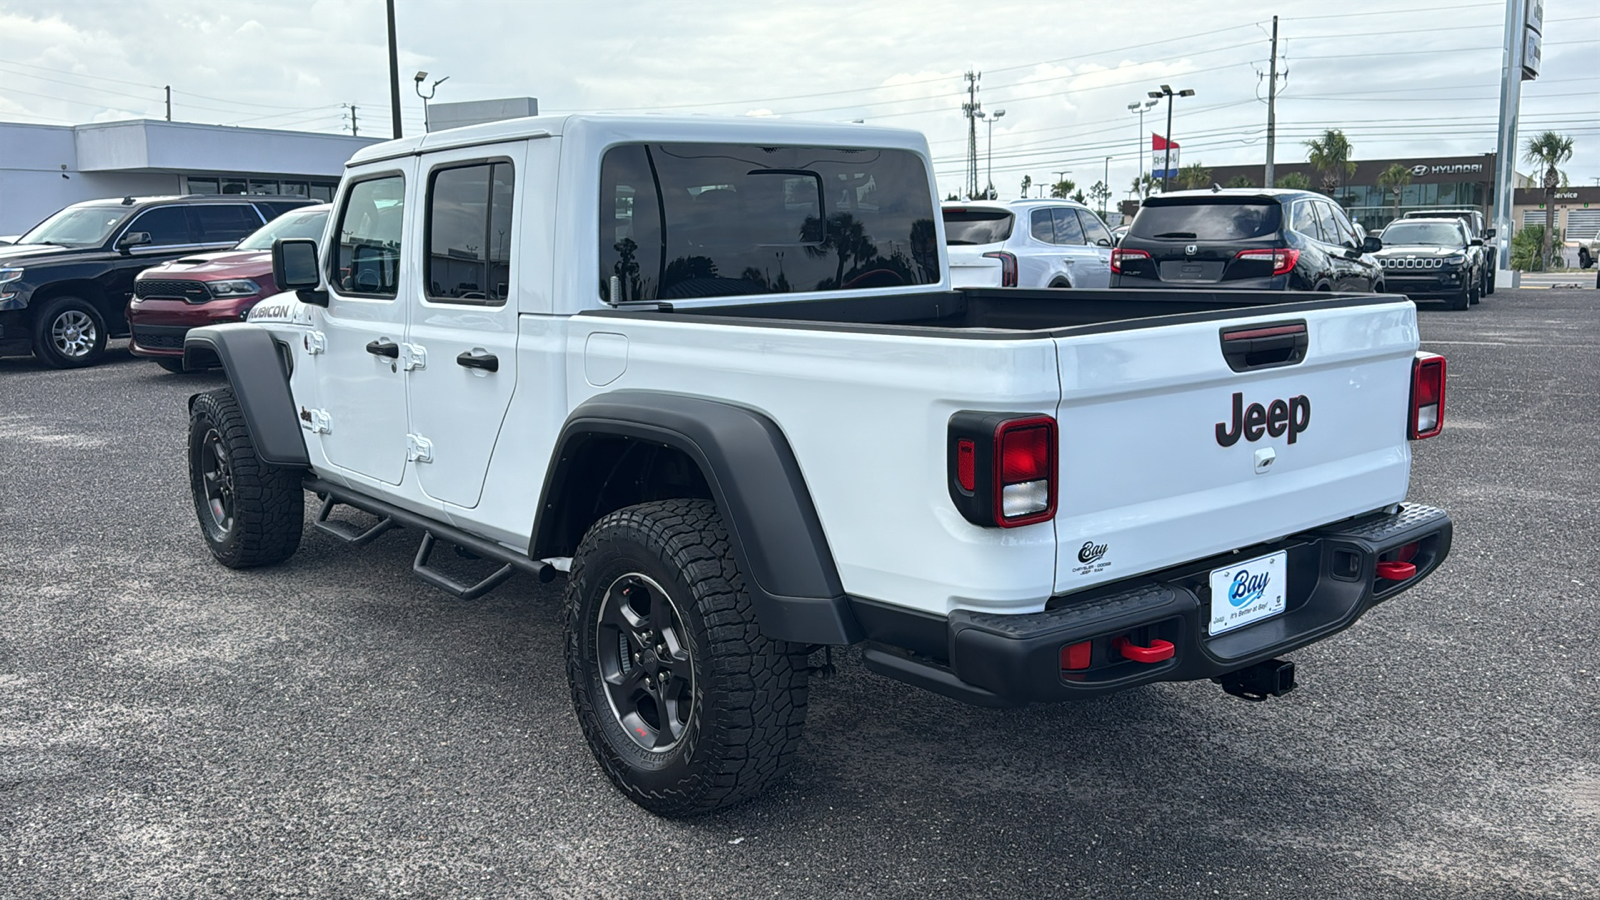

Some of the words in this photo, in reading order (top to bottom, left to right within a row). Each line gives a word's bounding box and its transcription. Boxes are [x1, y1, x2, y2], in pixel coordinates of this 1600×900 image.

[1431, 163, 1483, 174] HYUNDAI
[249, 305, 290, 319] RUBICON
[1215, 392, 1311, 448] Jeep
[1081, 541, 1109, 560] Bay
[1231, 569, 1271, 600] Bay
